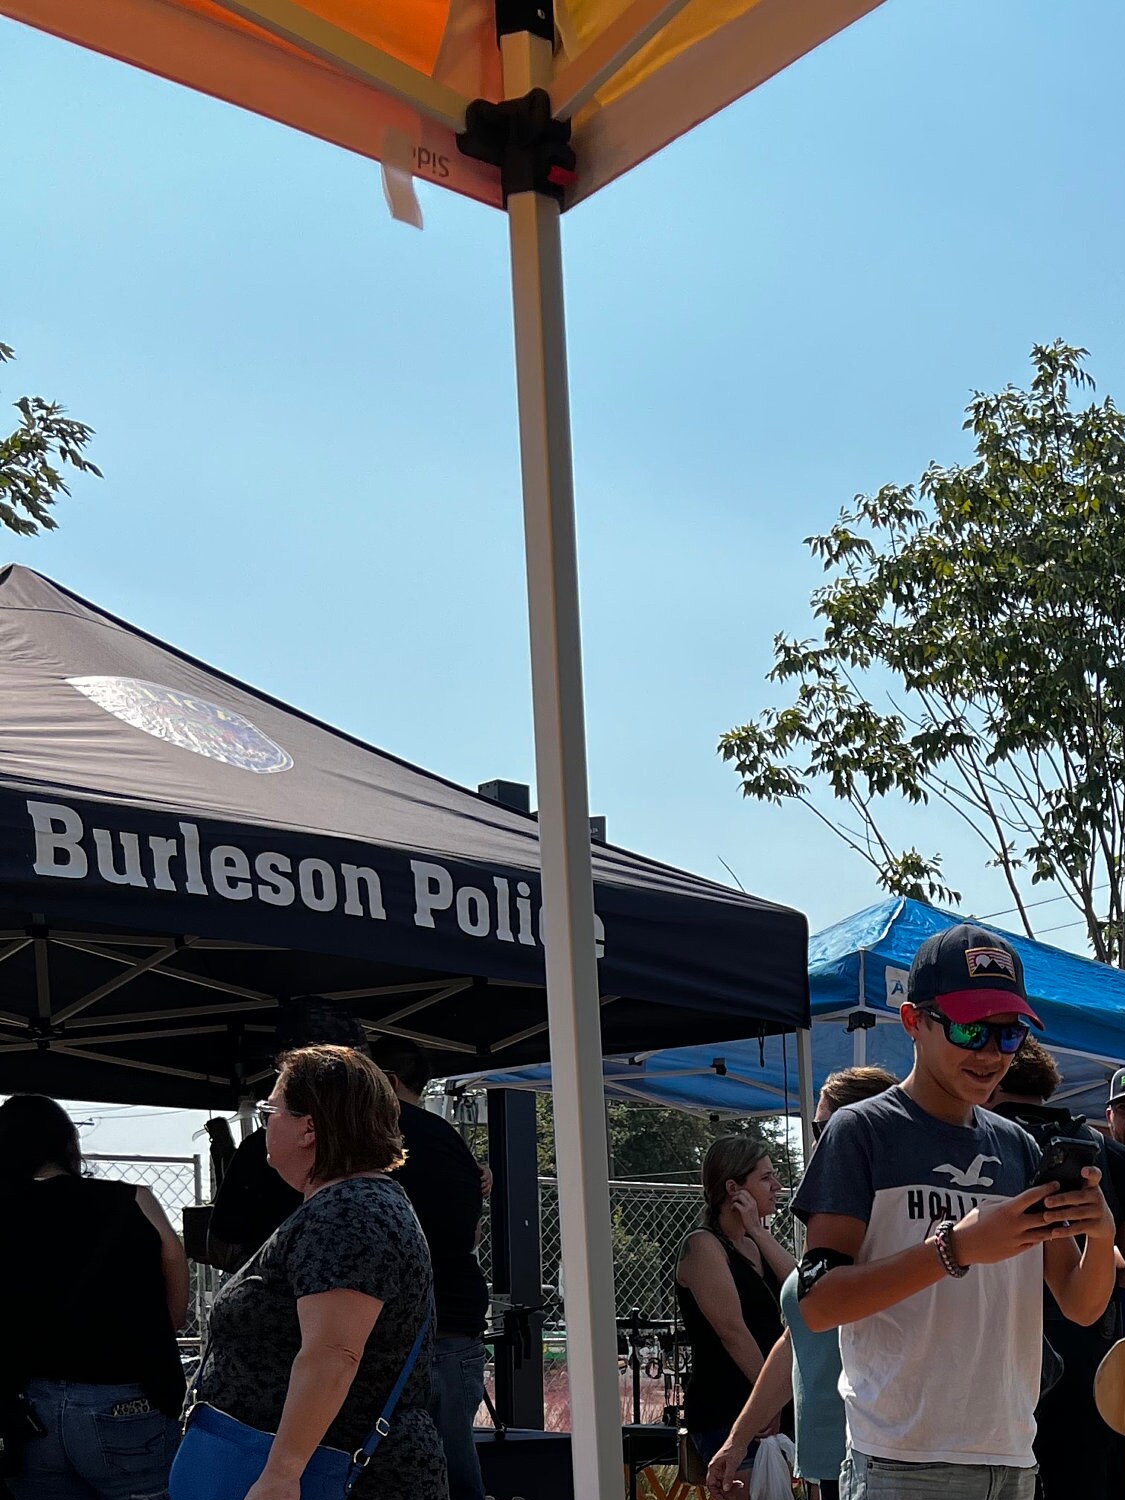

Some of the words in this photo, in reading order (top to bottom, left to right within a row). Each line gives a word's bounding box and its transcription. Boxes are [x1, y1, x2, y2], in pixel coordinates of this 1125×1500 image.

[413, 146, 450, 178] Sid
[26, 799, 387, 921] Burleson
[410, 859, 606, 959] Poli
